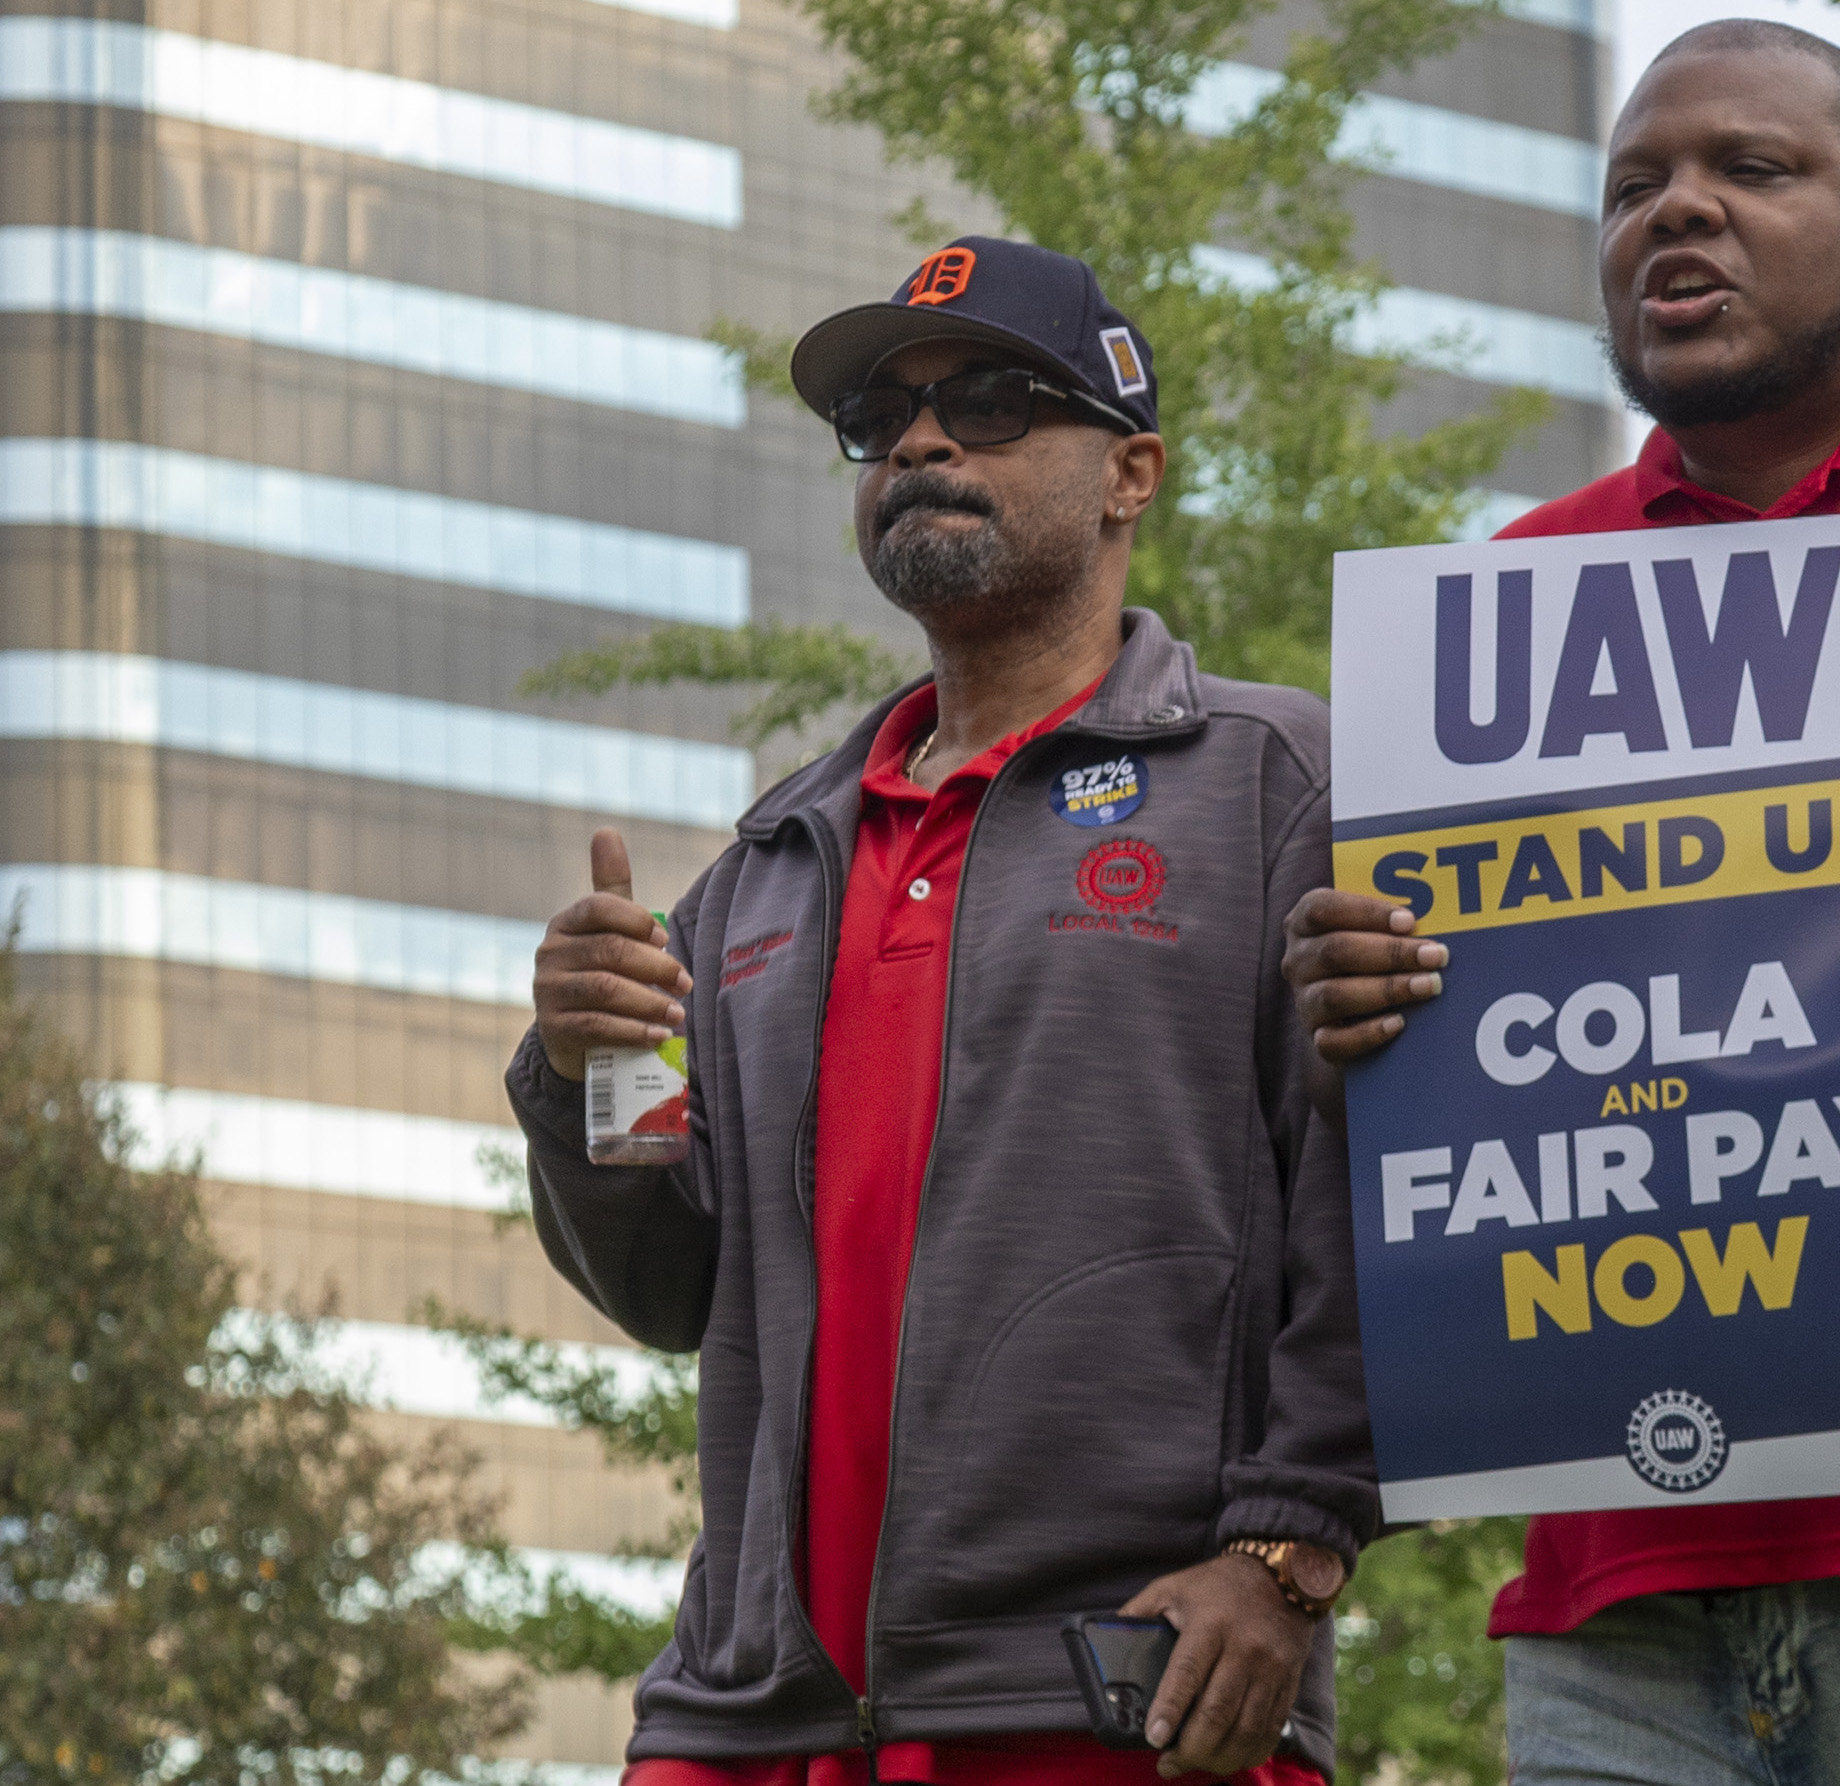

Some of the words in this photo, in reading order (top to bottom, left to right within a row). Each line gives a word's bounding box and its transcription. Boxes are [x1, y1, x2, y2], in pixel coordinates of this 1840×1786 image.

[908, 247, 977, 306] D
[1062, 754, 1135, 790] 97%
[1065, 780, 1114, 801] READY
[1116, 773, 1137, 787] TO
[1068, 782, 1139, 812] STRIKE
[1101, 868, 1140, 886] UAW
[1371, 814, 1726, 921] STAND
[1048, 914, 1123, 933] LOCAL
[1474, 961, 1818, 1086] COLA
[1600, 1077, 1689, 1118] AND
[1380, 1123, 1660, 1243] FAIR
[1501, 1215, 1811, 1341] NOW
[1654, 1426, 1695, 1450] UAW
